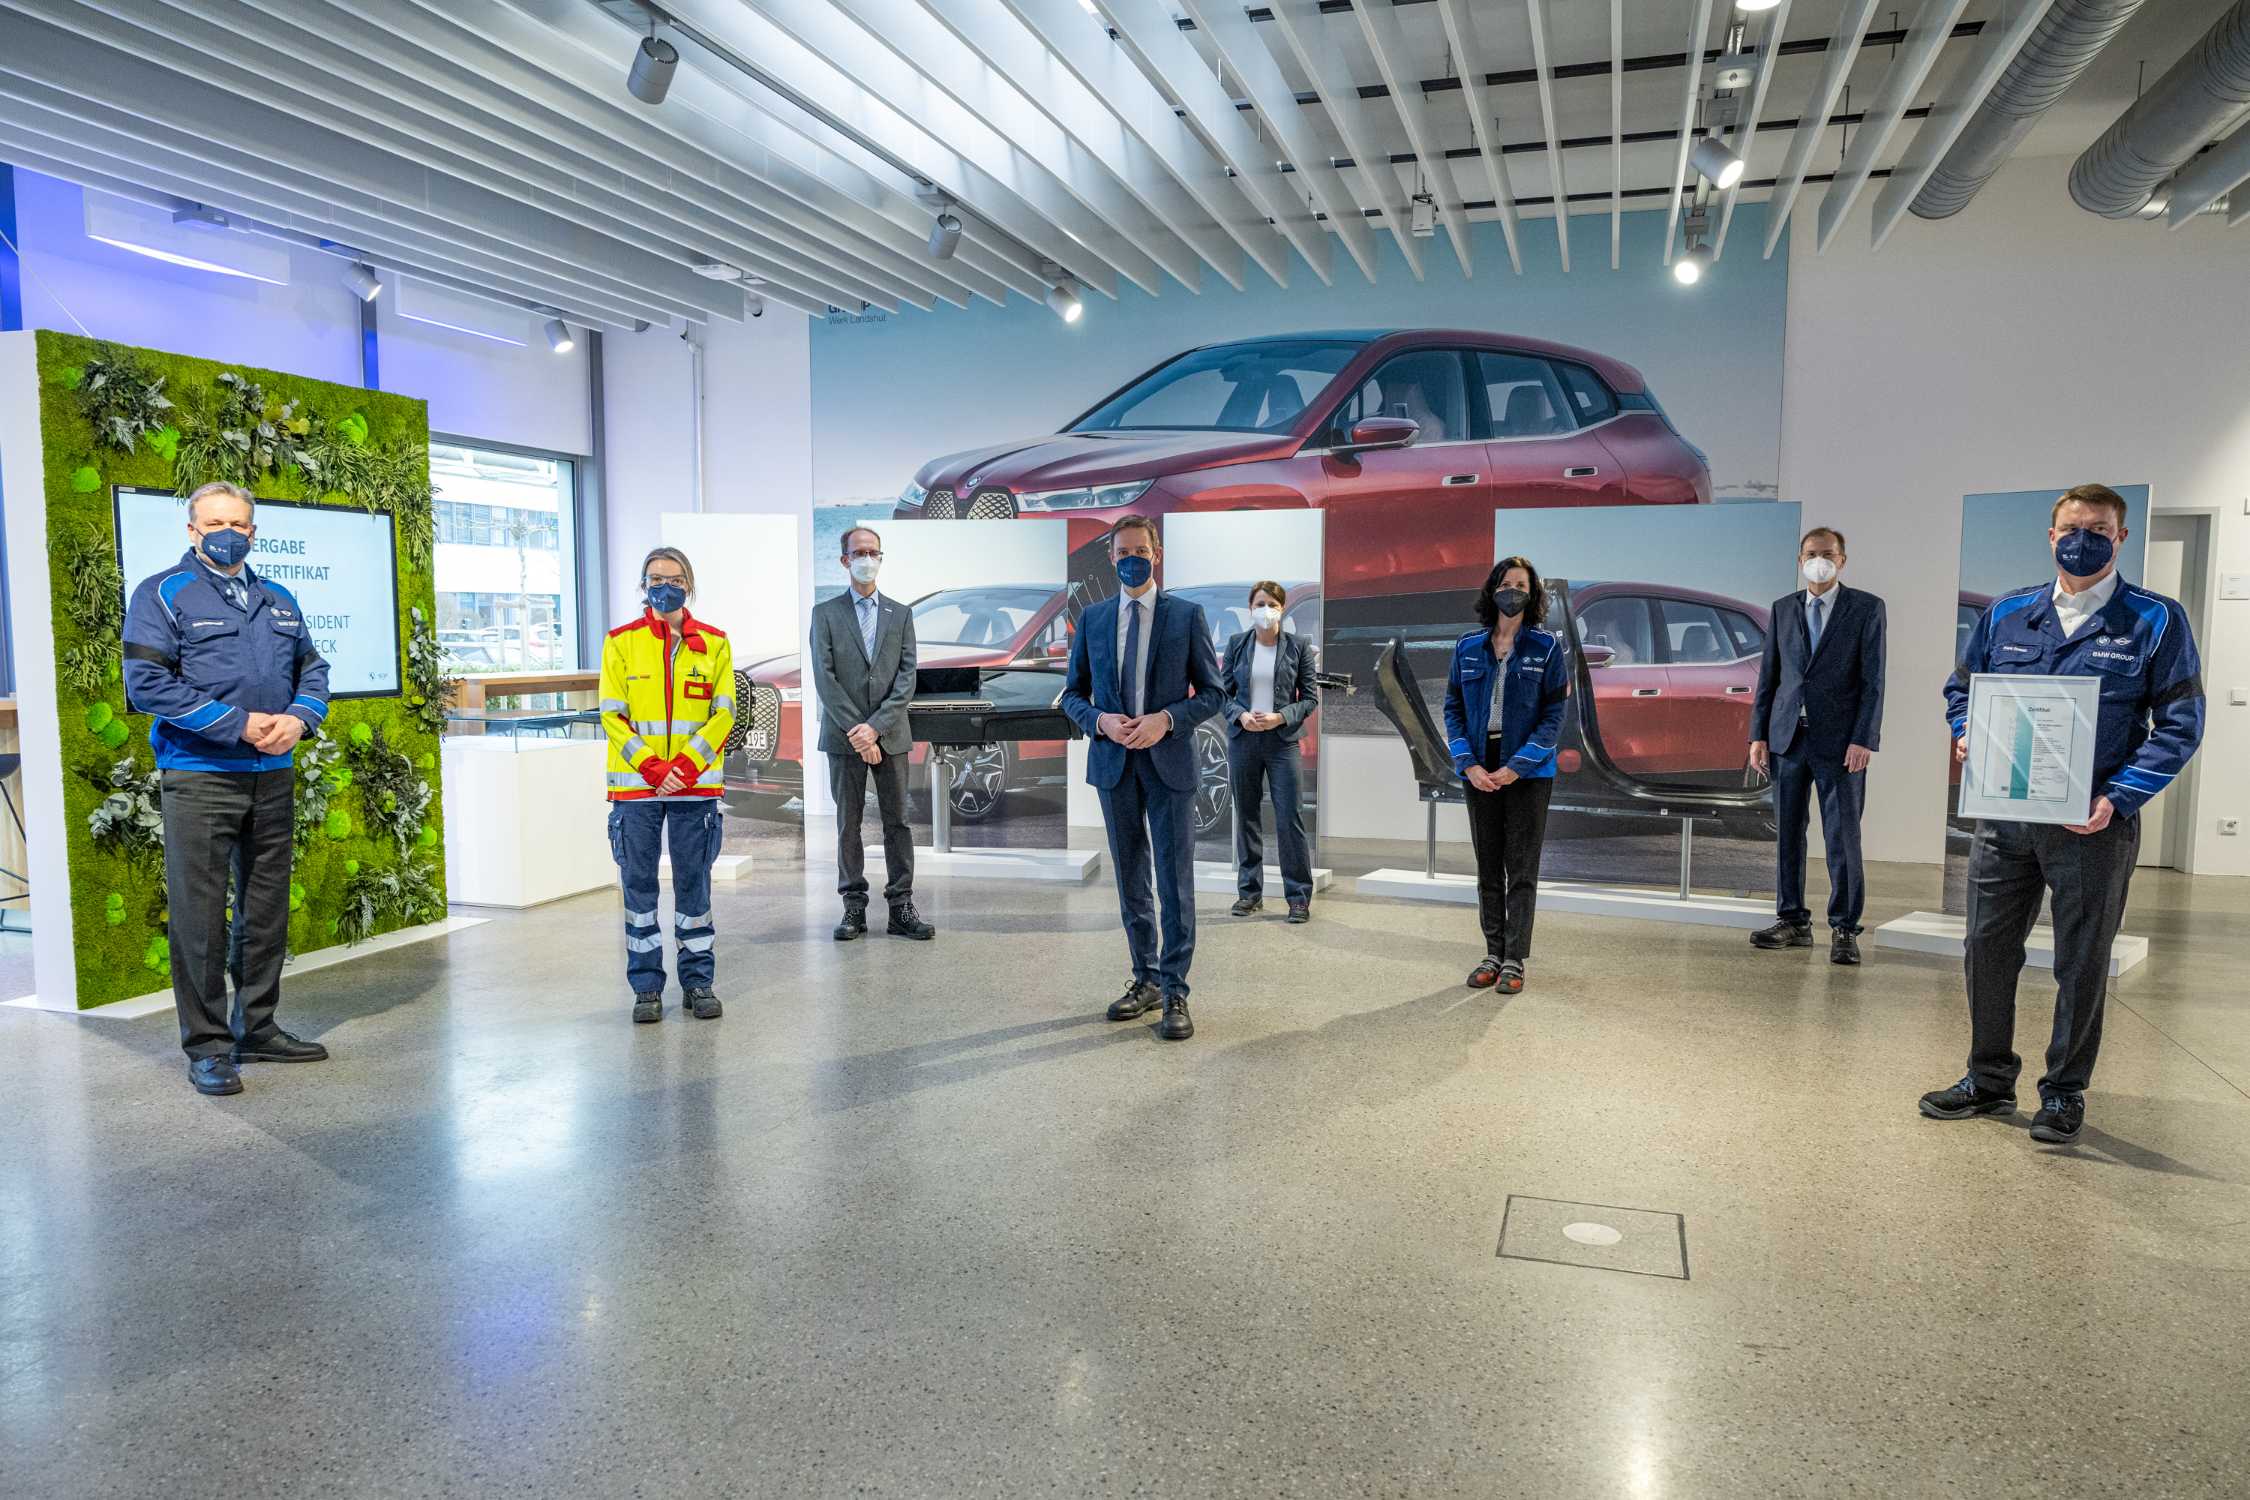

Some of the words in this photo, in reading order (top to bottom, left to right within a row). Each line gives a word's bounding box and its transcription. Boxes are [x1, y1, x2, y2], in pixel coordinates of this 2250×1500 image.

[251, 537, 306, 555] ERGABE
[305, 615, 351, 629] SIDENT
[314, 639, 337, 654] ECK
[2110, 652, 2135, 662] GROUP
